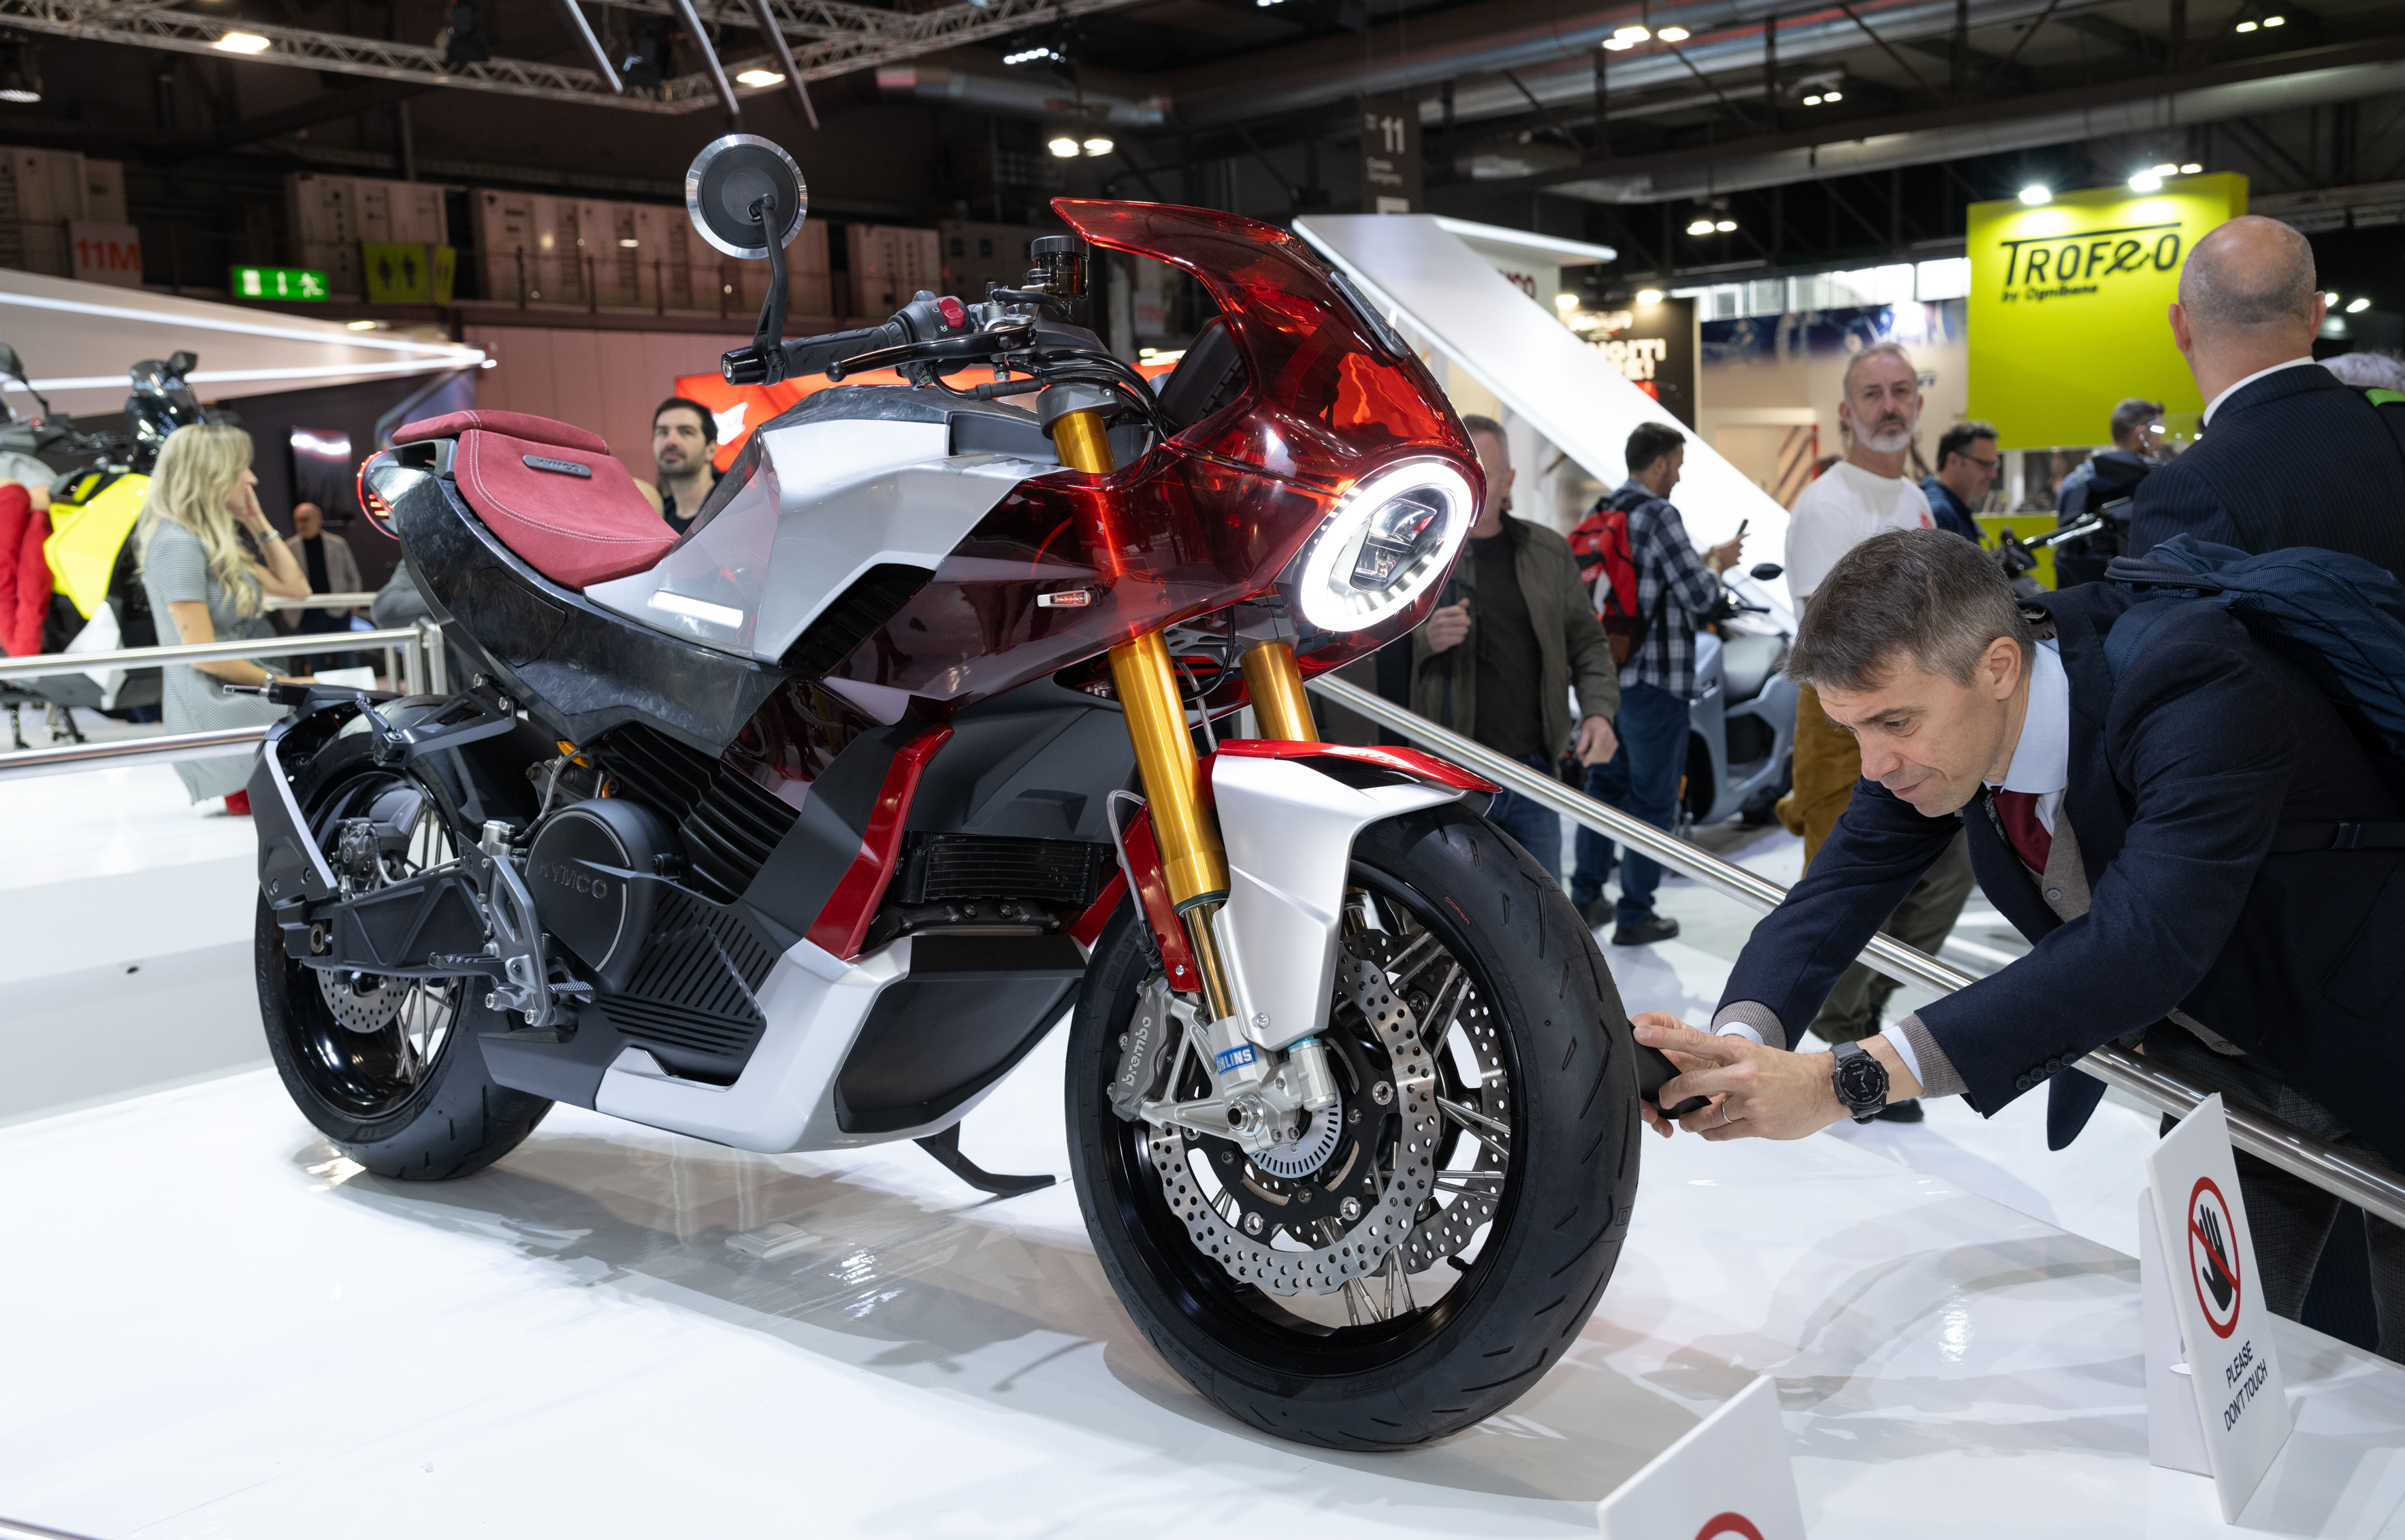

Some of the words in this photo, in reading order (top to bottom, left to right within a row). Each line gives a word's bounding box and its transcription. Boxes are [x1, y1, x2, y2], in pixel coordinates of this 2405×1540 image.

[1380, 116, 1405, 154] 11
[74, 239, 140, 272] 11M
[538, 857, 608, 899] KYMCO
[1444, 896, 1470, 925] CORSA
[1122, 1016, 1152, 1087] brembo
[2225, 1339, 2254, 1389] PLEASE
[2223, 1388, 2246, 1432] DON'T
[2244, 1358, 2268, 1403] TOUCH
